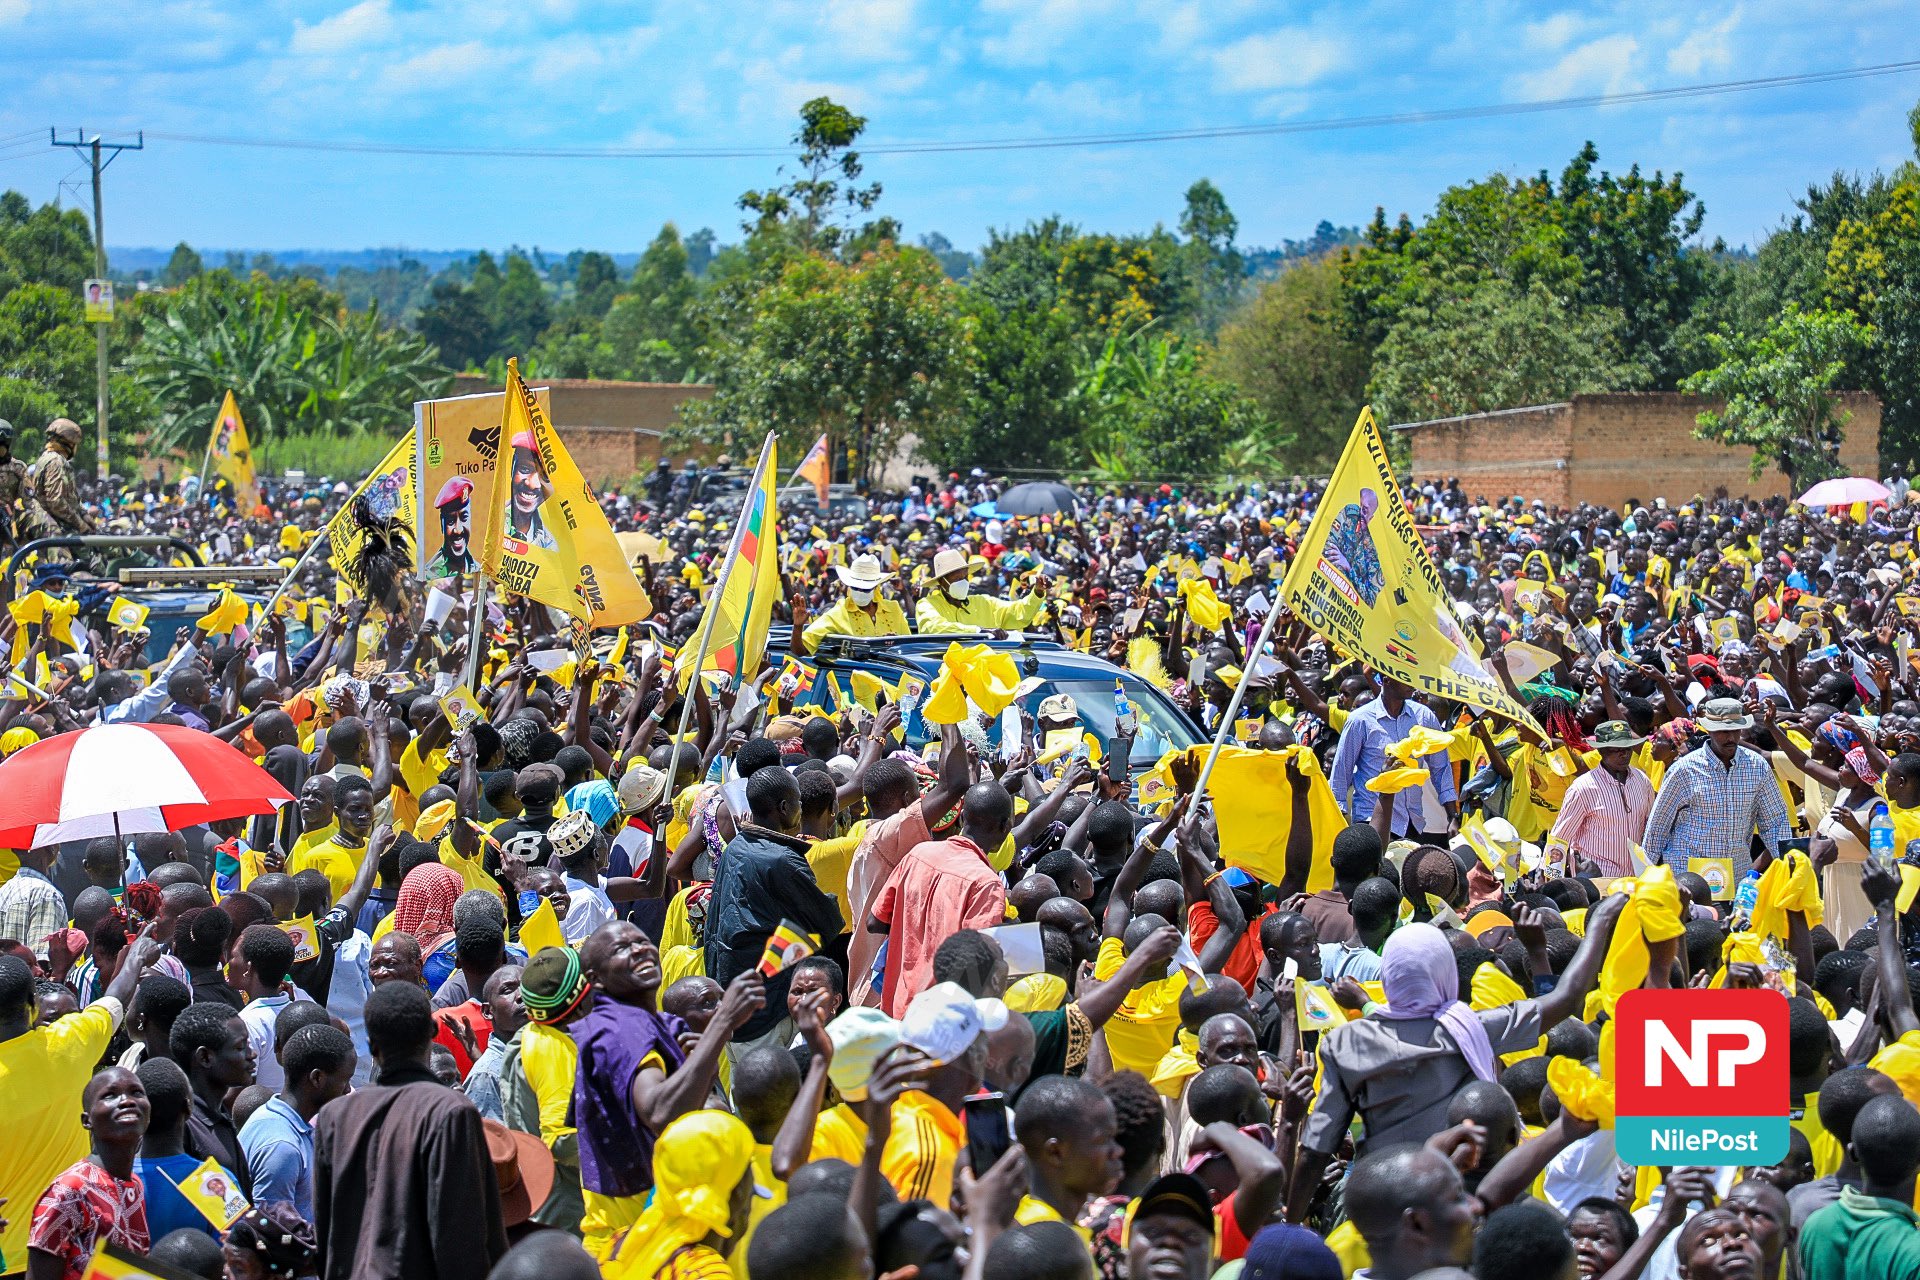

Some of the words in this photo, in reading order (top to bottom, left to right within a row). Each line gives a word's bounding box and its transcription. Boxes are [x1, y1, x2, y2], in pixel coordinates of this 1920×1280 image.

[455, 460, 480, 475] Tuko
[482, 459, 497, 472] Pa
[1310, 571, 1326, 595] GEN.
[1319, 561, 1349, 595] CHAIRMAN
[1291, 590, 1411, 682] PROTECTING
[1419, 675, 1469, 698] THE
